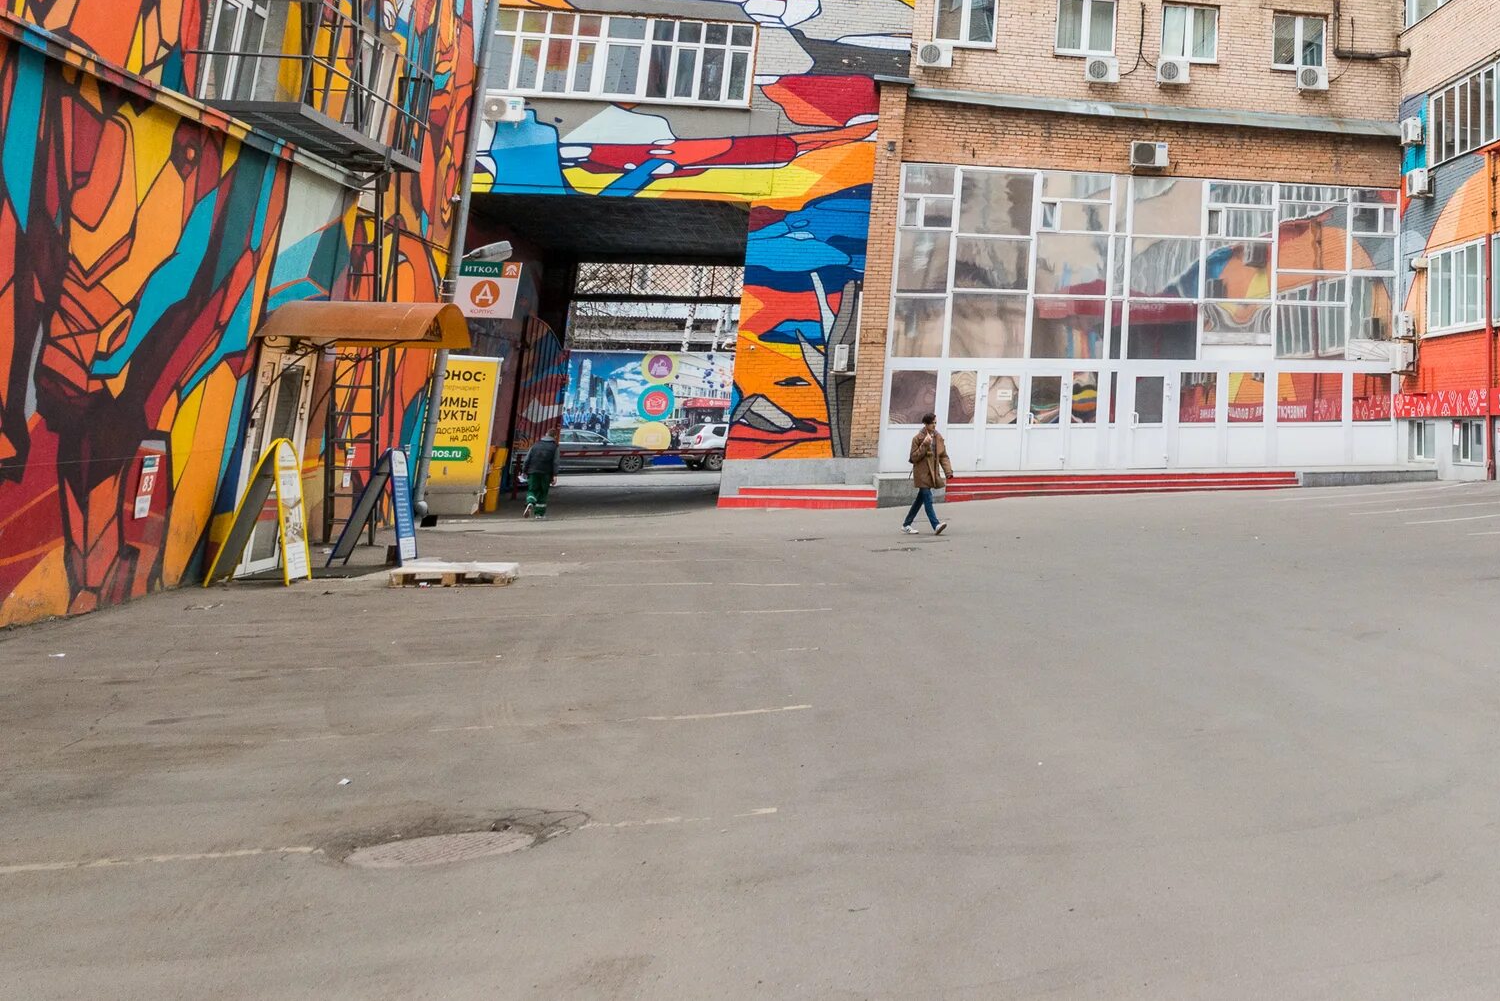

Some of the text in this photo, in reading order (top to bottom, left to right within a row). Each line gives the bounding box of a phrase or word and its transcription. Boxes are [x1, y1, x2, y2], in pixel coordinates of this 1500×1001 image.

[464, 265, 499, 274] ИТКОЛ
[475, 283, 494, 304] Д
[444, 369, 486, 382] ОНОС:
[440, 396, 479, 408] ИМЫЕ
[439, 409, 477, 422] УКТЫ
[436, 423, 480, 434] ДОСТАВКОЙ
[460, 433, 479, 442] ДОМ
[431, 450, 462, 458] nos.ru
[142, 475, 154, 493] 83
